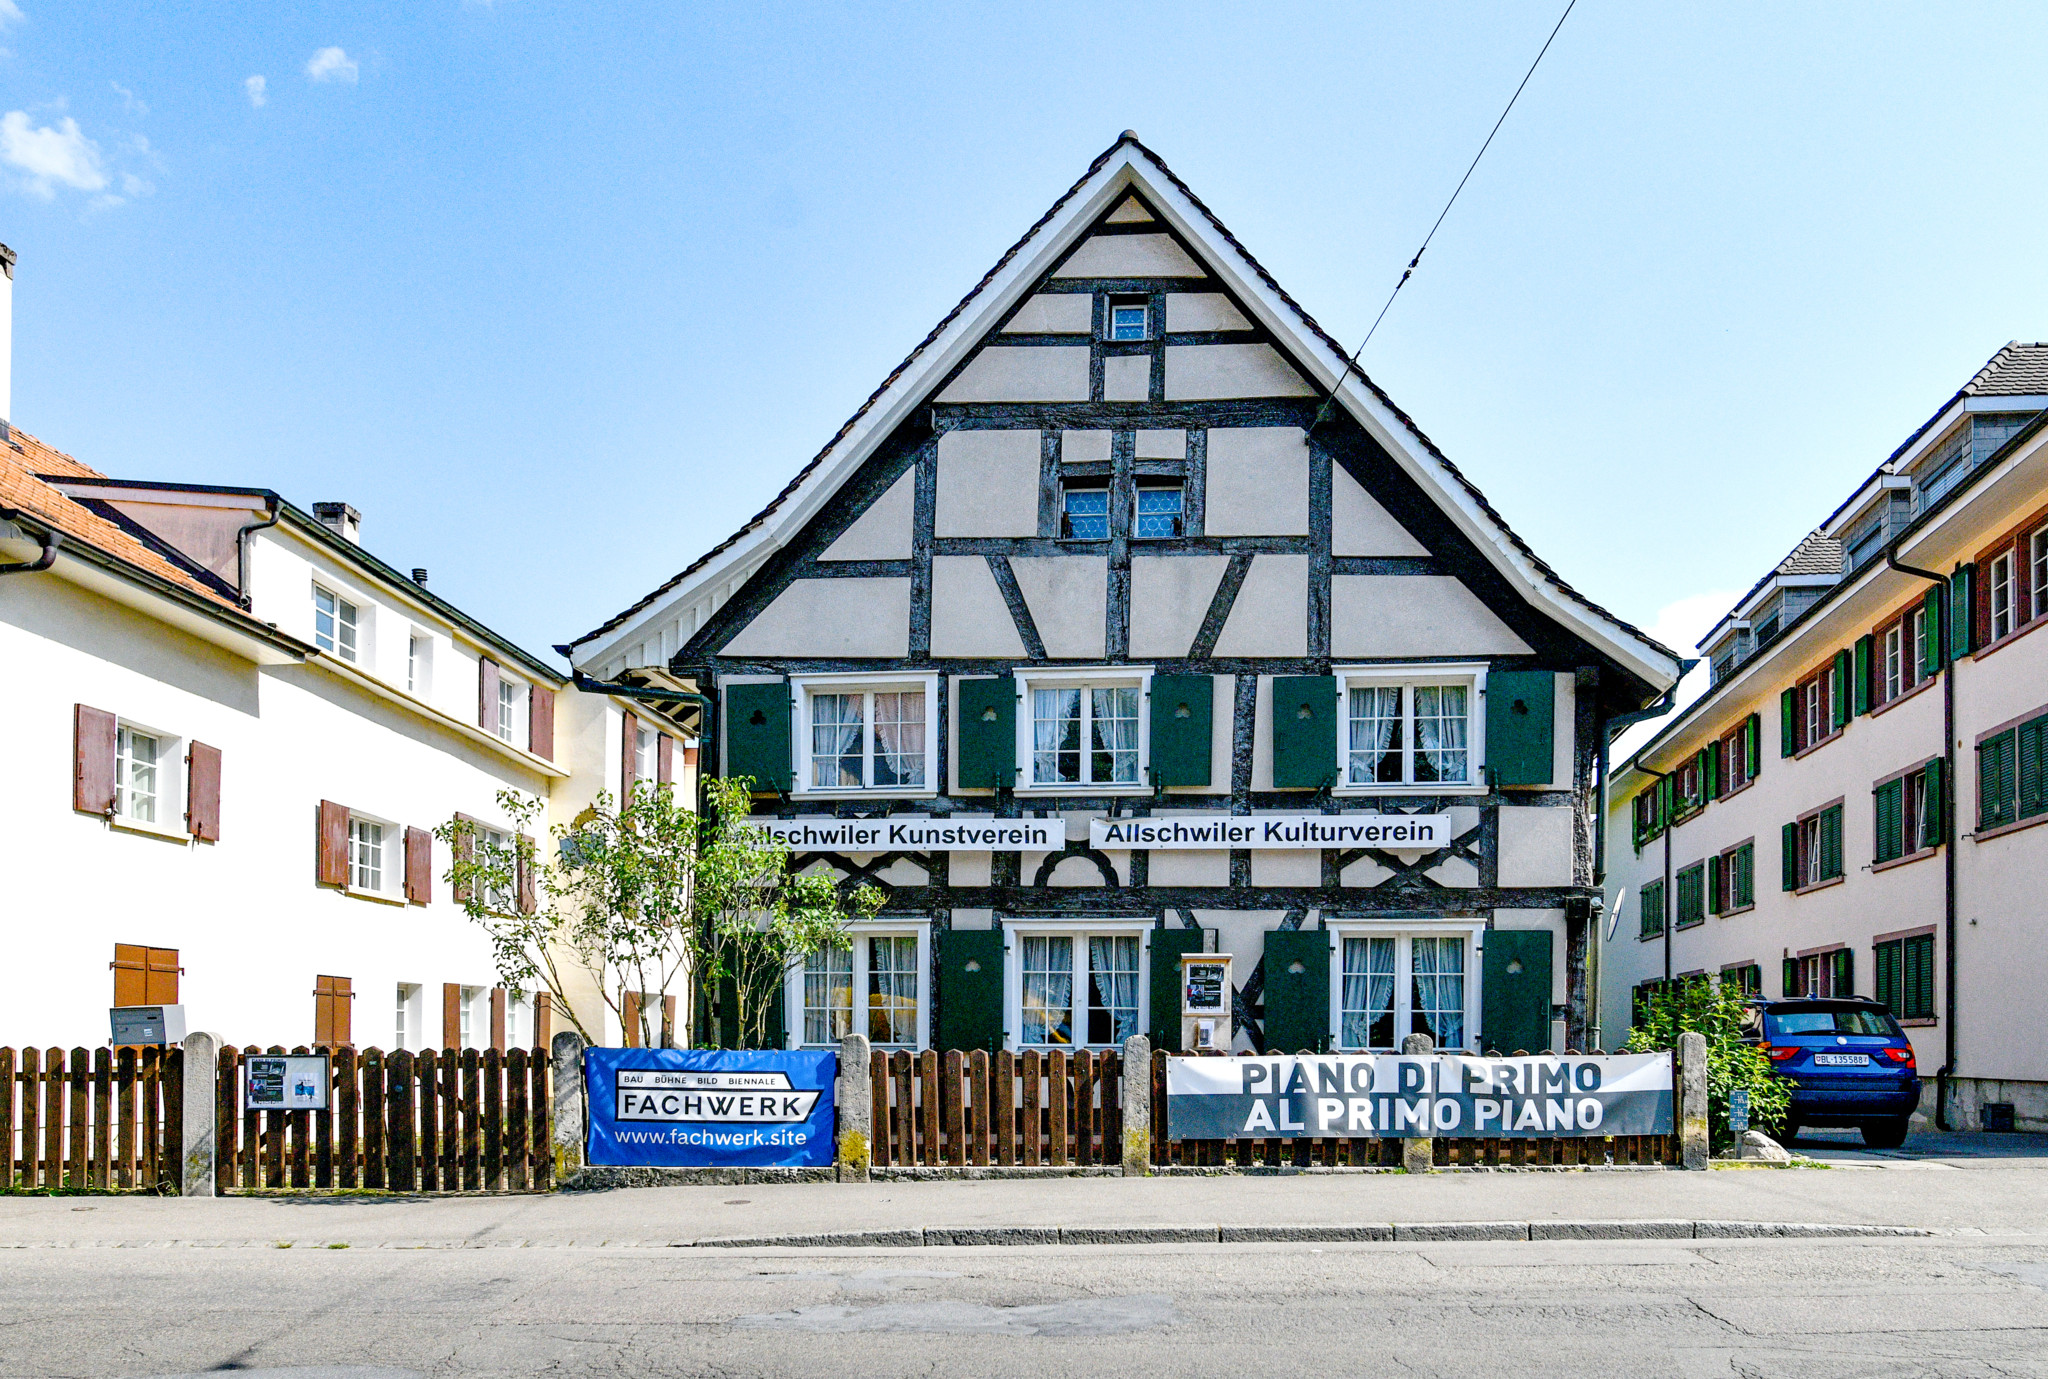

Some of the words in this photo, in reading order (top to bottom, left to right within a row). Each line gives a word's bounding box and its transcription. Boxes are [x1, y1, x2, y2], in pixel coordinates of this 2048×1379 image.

[741, 824, 881, 845] lschwiler
[889, 823, 1048, 845] Kunstverein
[1104, 822, 1255, 843] Allschwiler
[1264, 820, 1434, 842] Kulturverein
[624, 1075, 644, 1084] BAU
[654, 1074, 687, 1085] BÜHNE
[697, 1077, 718, 1085] BILD
[728, 1077, 776, 1086] BIENNALE
[1242, 1062, 1375, 1095] PIANO
[1398, 1062, 1440, 1095] DI
[1462, 1062, 1602, 1095] PRIMO
[624, 1094, 801, 1117] FACHWERK
[1243, 1098, 1305, 1132] AL
[1318, 1097, 1461, 1131] PRIMO
[1474, 1097, 1604, 1132] PIANO
[614, 1128, 807, 1146] www.fachwerk.site
